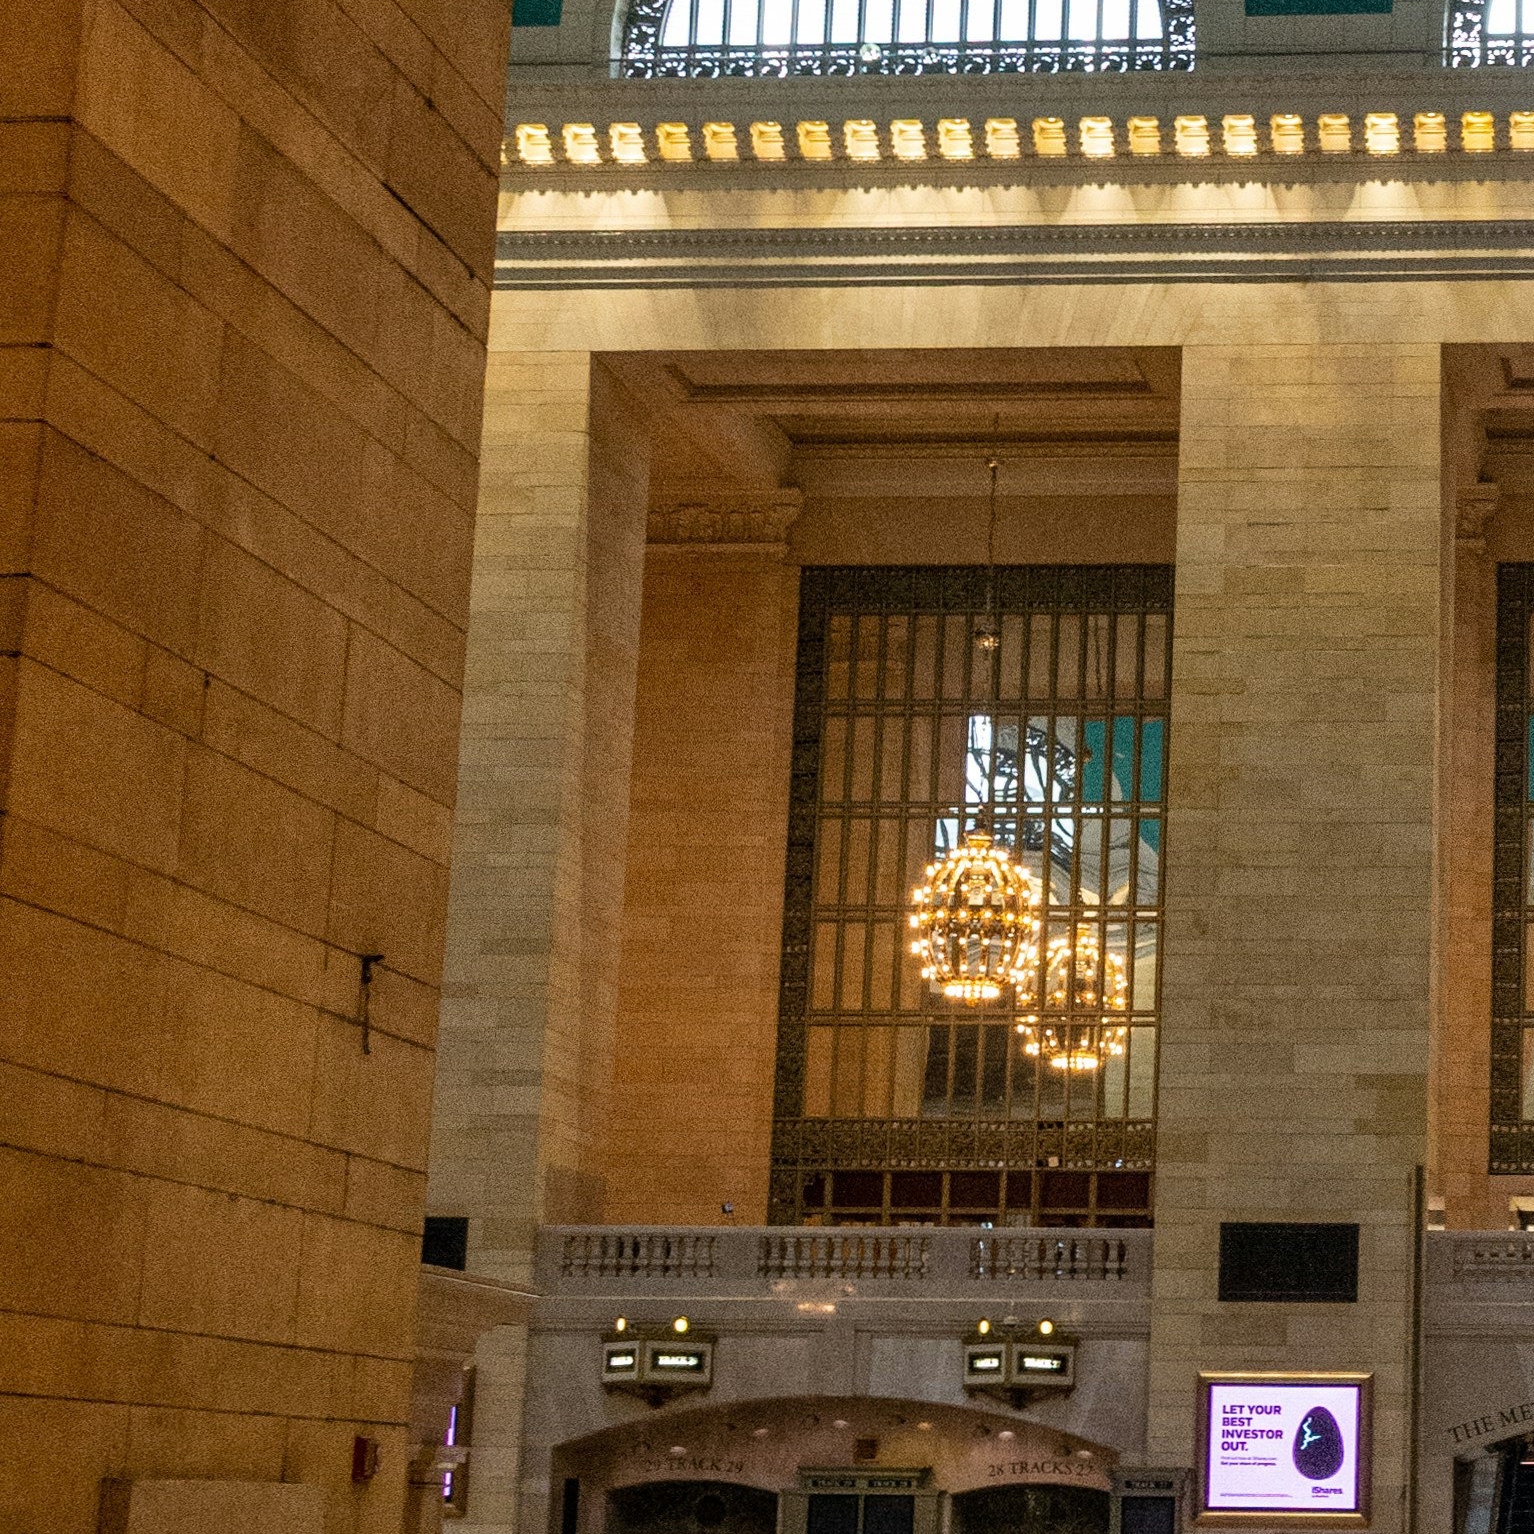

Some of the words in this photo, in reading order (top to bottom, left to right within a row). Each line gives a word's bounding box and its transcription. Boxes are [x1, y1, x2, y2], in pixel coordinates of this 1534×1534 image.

[1222, 1405, 1245, 1415] LET
[1247, 1405, 1282, 1415] YOUR
[1221, 1417, 1253, 1427] BEST
[1221, 1429, 1284, 1439] INVESTOR
[1449, 1415, 1496, 1444] THE
[1221, 1441, 1248, 1451] OUT.
[1009, 1460, 1073, 1475] TRACKS
[1311, 1486, 1343, 1495] iShares
